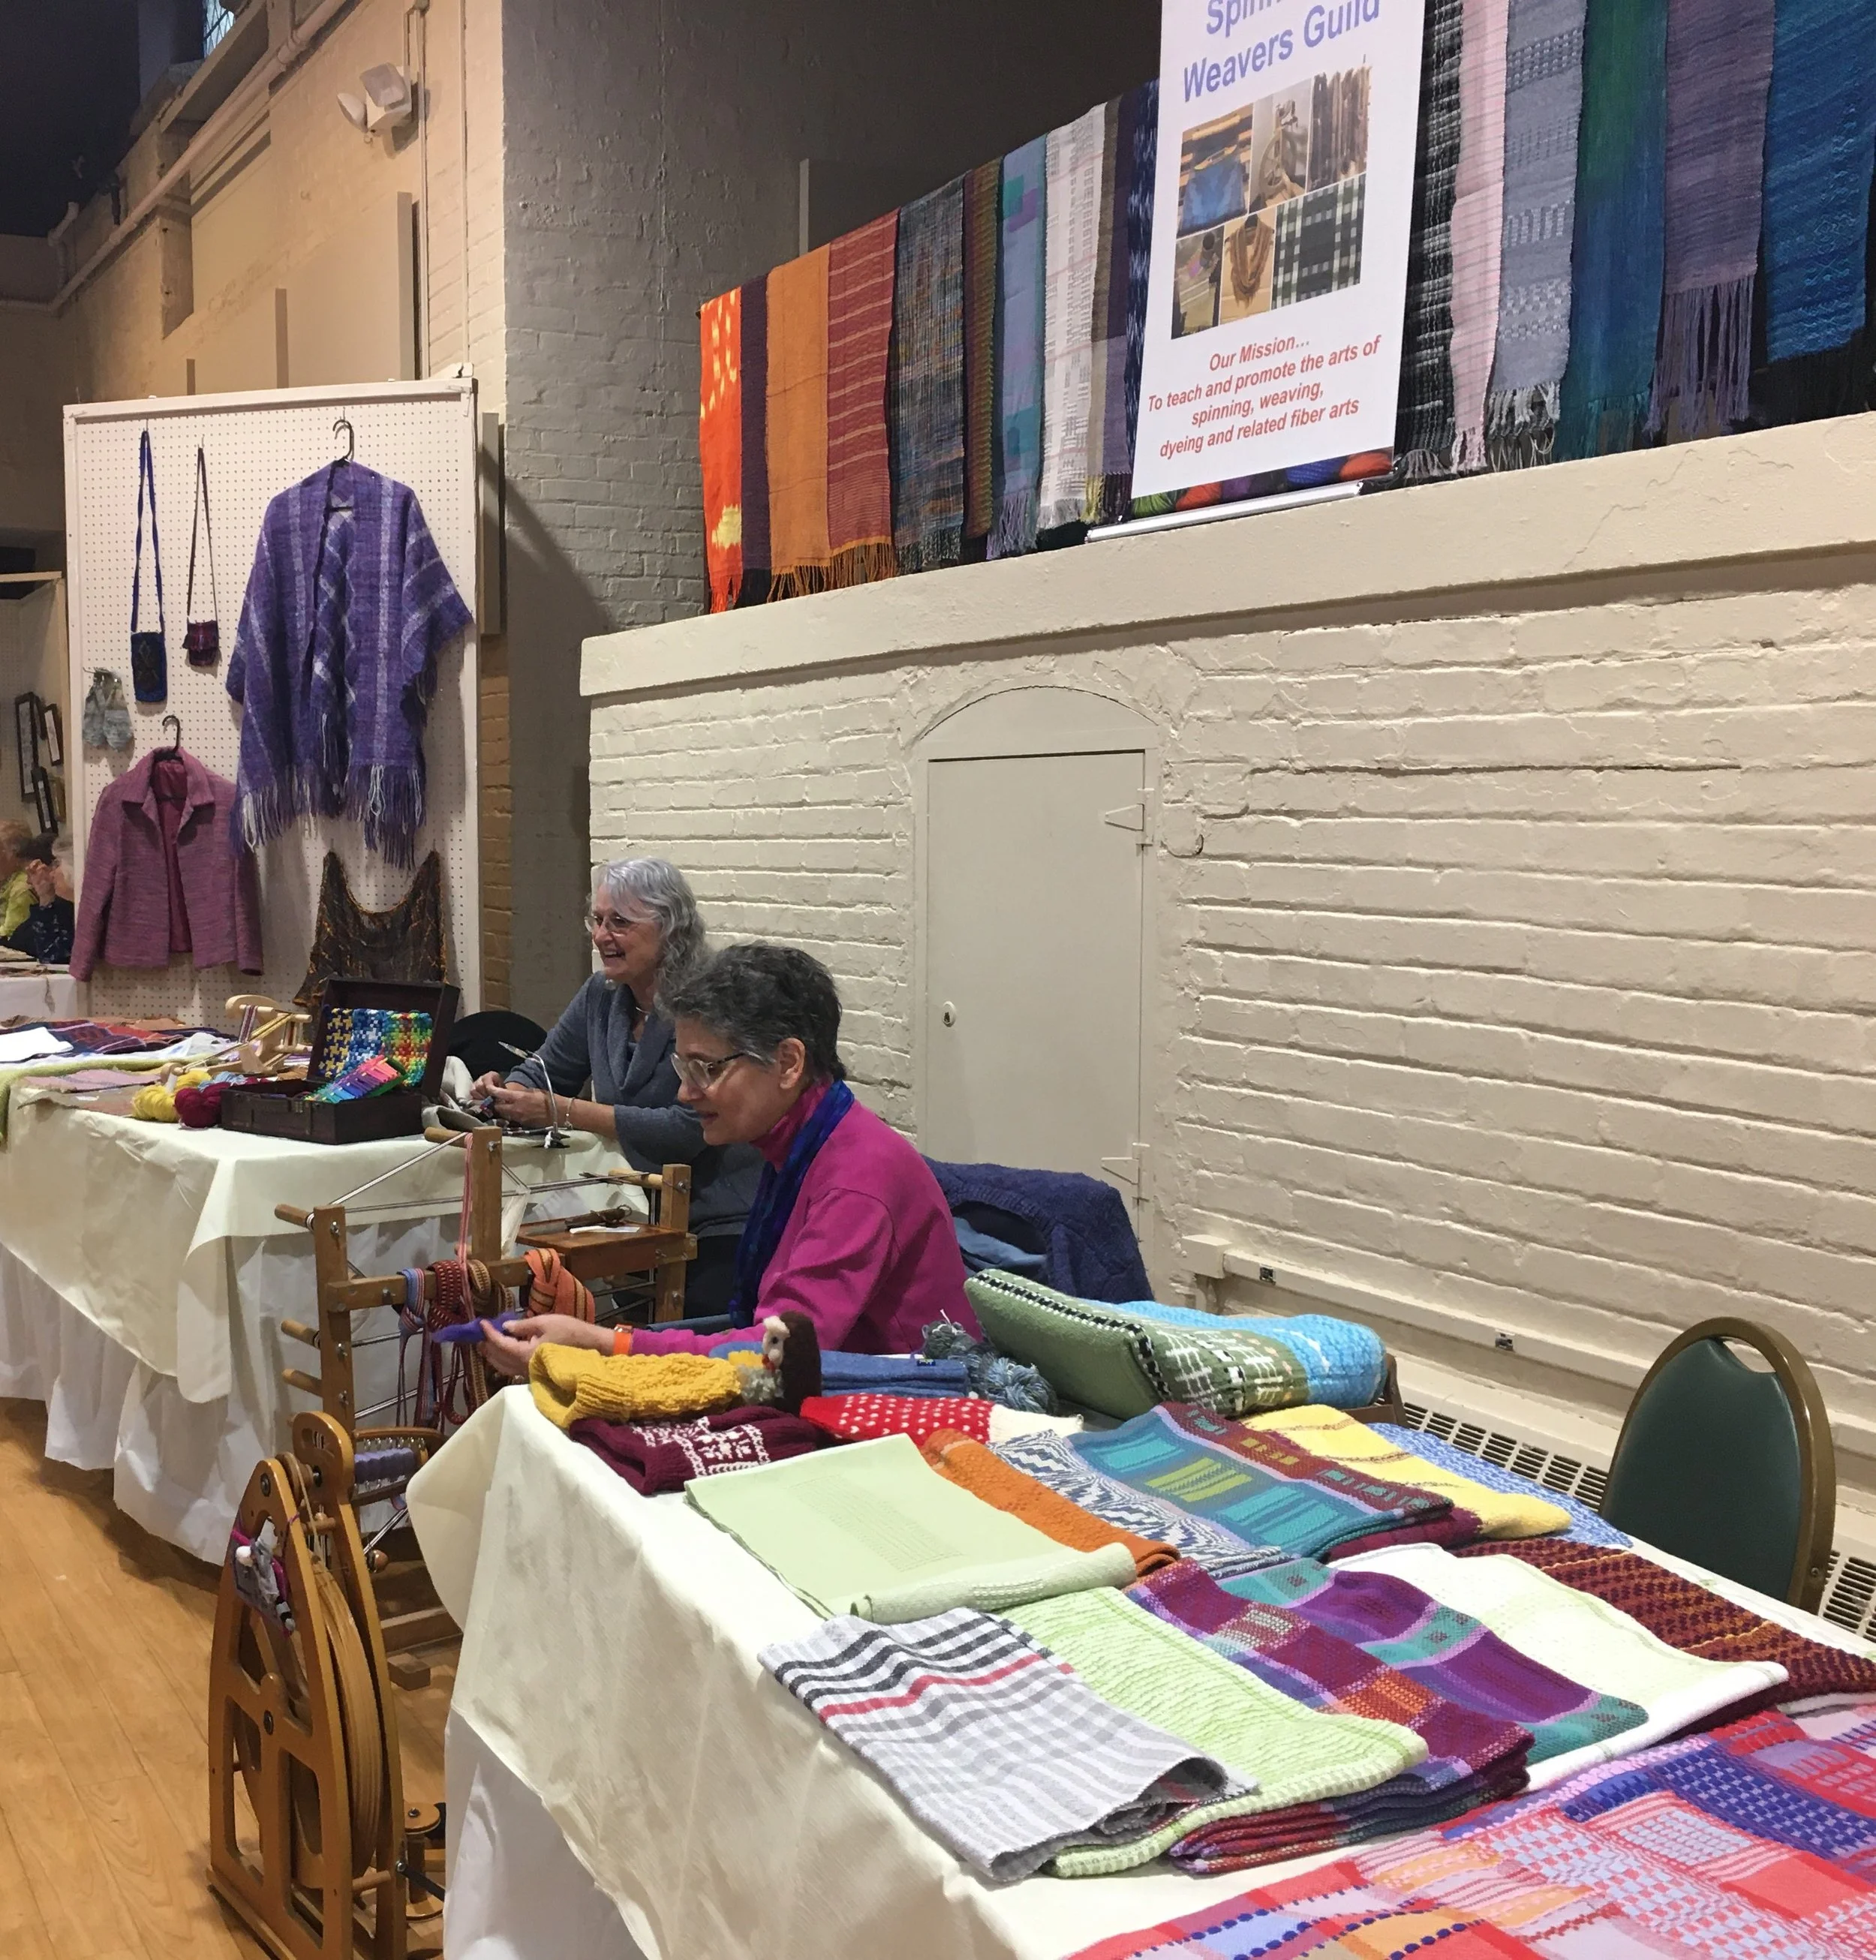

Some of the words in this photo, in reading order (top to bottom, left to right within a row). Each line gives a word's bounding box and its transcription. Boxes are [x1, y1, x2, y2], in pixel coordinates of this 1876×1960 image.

[1183, 29, 1293, 102] Weavers
[1304, 0, 1380, 47] Guild
[1149, 395, 1162, 412] To
[1167, 383, 1202, 407] teach
[1205, 374, 1233, 398] and
[1234, 362, 1296, 395] promote
[1300, 354, 1324, 374] the
[1328, 344, 1358, 366] arts
[1363, 334, 1381, 356] of
[1210, 353, 1237, 371] Our
[1239, 335, 1309, 363] Mission...
[1160, 435, 1204, 460] dyeing
[1207, 424, 1234, 446] and
[1237, 412, 1287, 440] related
[1291, 407, 1326, 428] fiber
[1329, 398, 1359, 419] arts
[1192, 399, 1254, 428] spinning,
[1260, 382, 1323, 409] weaving,
